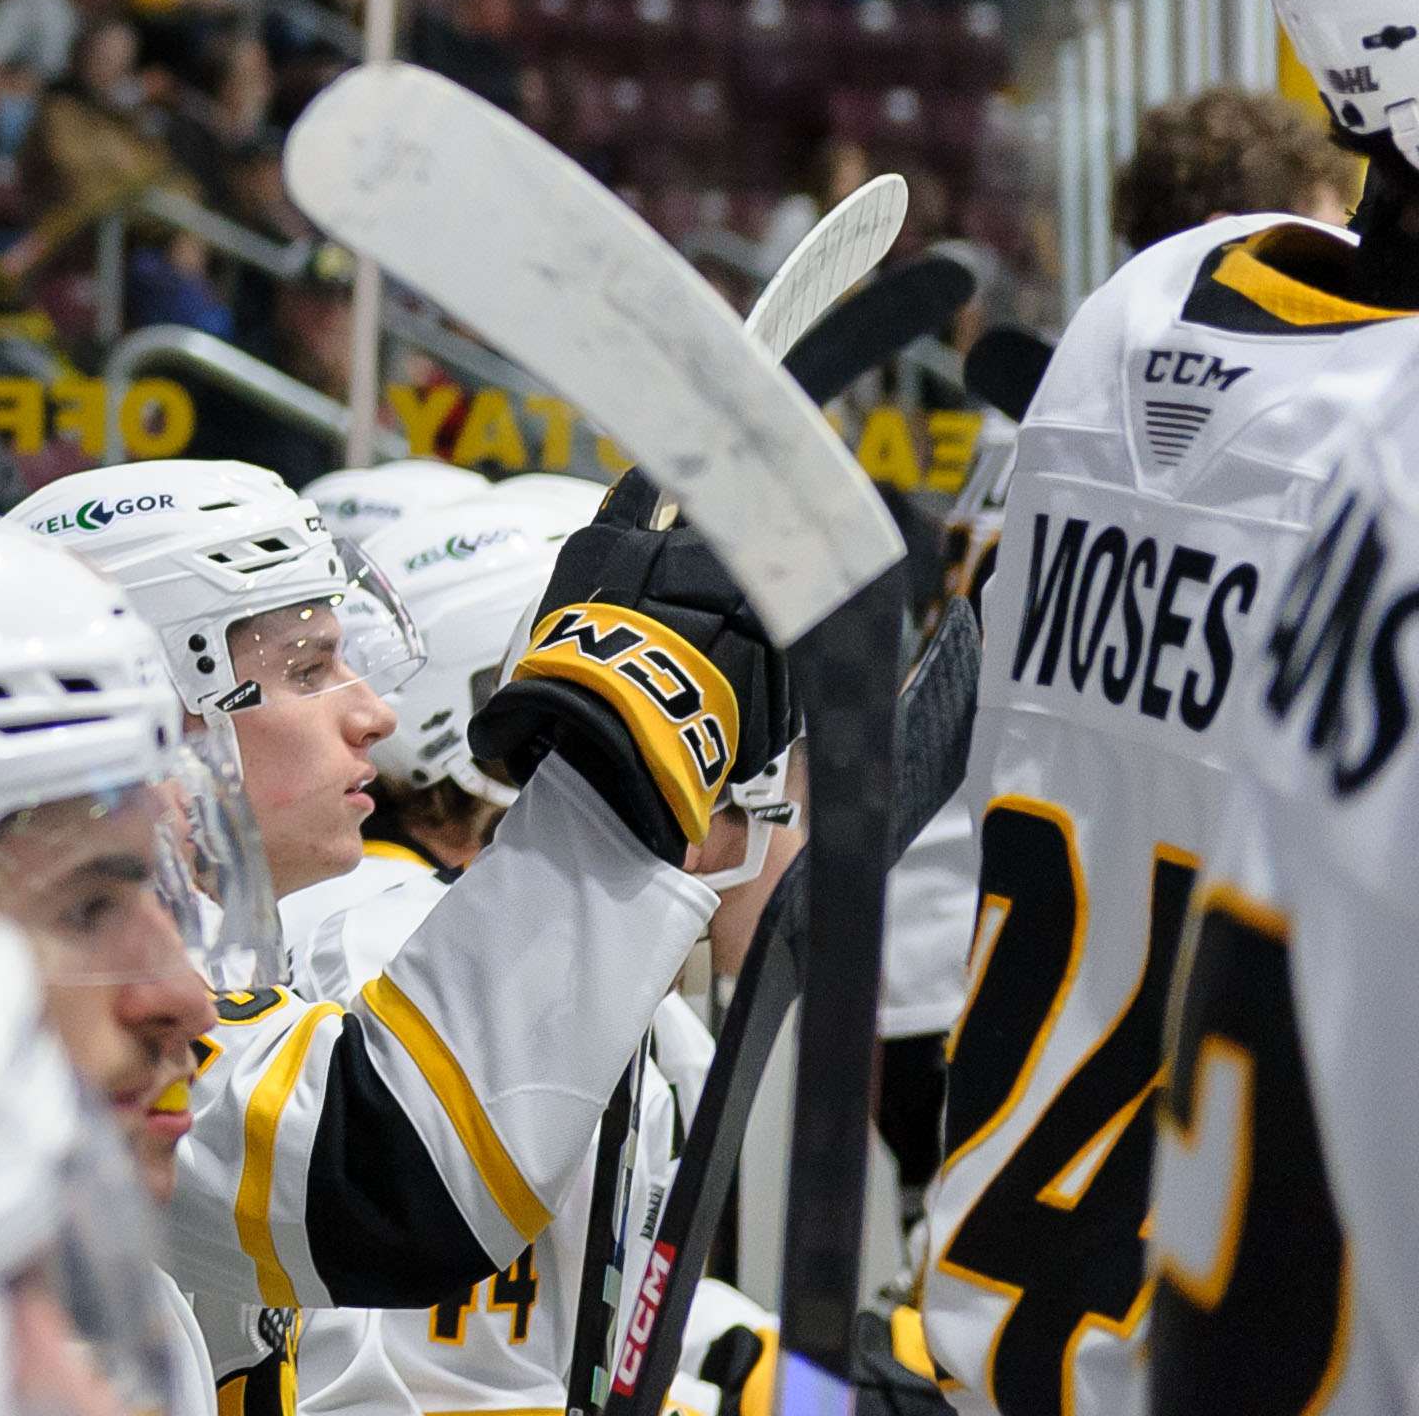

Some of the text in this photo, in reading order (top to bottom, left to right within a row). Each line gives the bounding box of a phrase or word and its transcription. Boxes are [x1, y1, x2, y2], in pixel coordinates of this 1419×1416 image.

[1144, 350, 1253, 392] CCM
[115, 494, 175, 515] GOR
[532, 610, 731, 790] CCM
[617, 1249, 672, 1386] CCM
